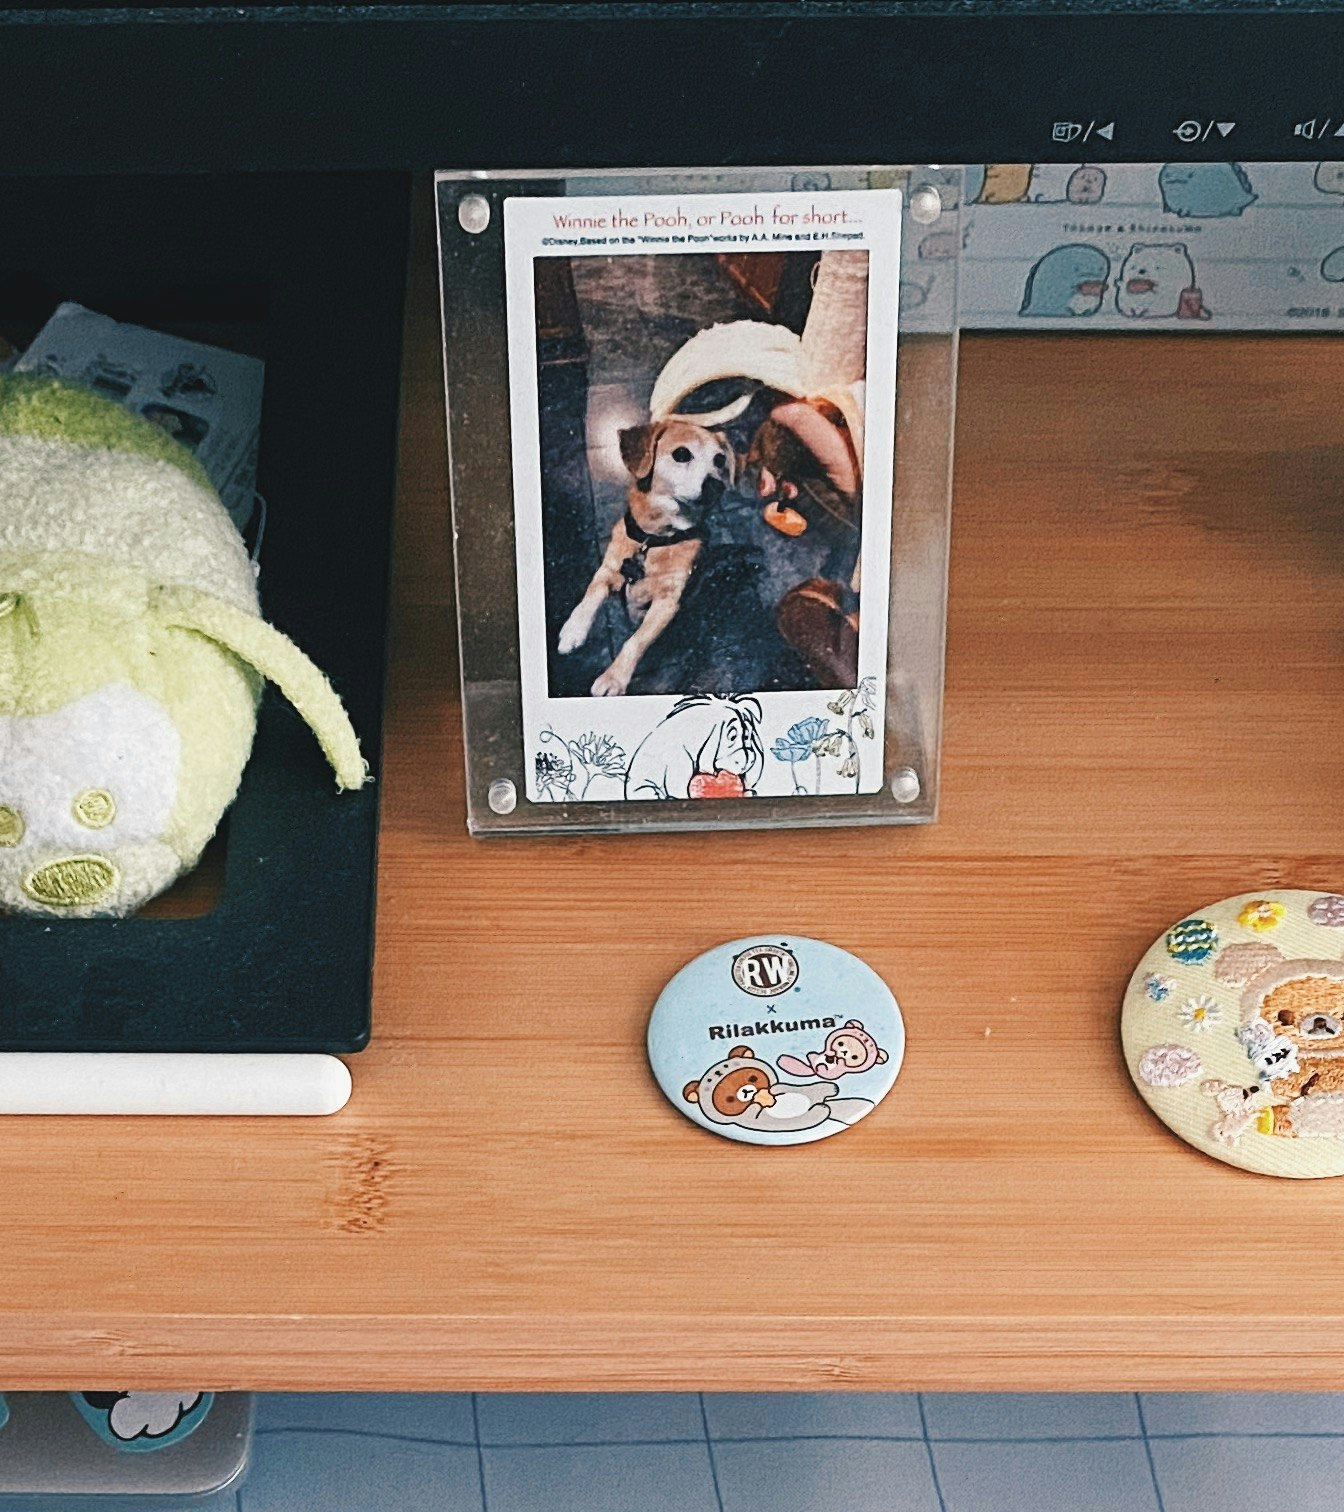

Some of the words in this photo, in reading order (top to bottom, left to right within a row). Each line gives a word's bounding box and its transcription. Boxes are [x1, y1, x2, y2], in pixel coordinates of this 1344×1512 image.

[552, 214, 607, 229] Winnie
[611, 207, 639, 228] the
[643, 206, 692, 230] Pooh,
[696, 213, 716, 227] or
[720, 204, 764, 226] Pooh
[772, 204, 799, 226] for
[742, 955, 790, 988] RW
